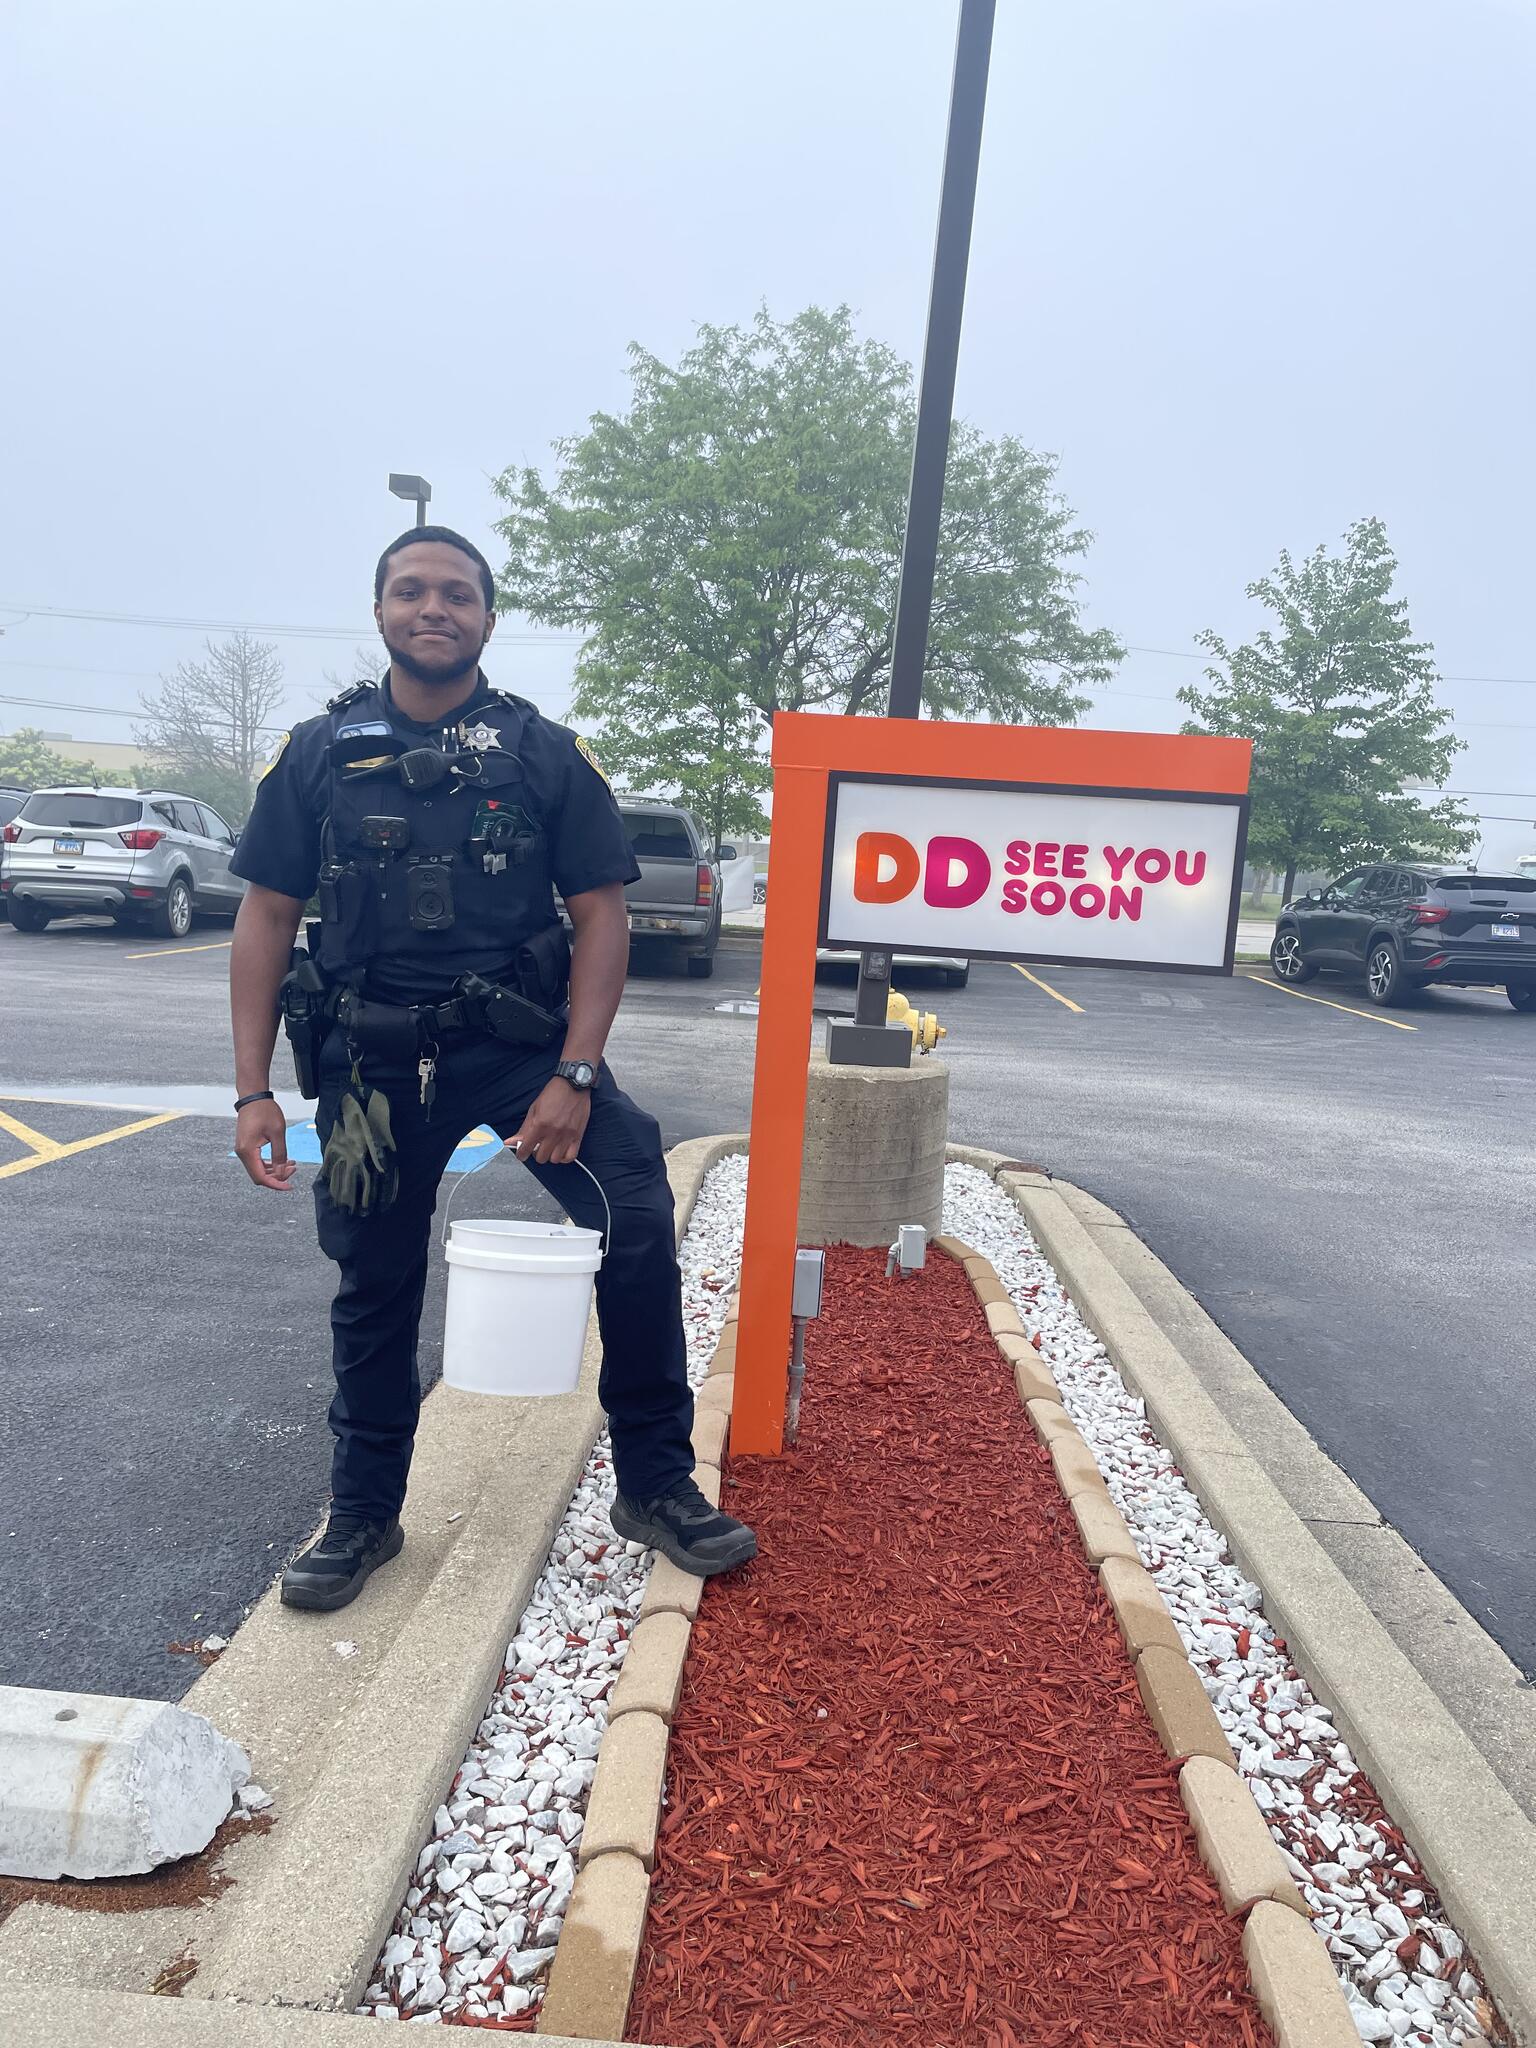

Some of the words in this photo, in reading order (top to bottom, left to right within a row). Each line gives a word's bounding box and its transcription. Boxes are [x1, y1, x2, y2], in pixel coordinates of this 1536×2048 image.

[853, 831, 992, 909] DD
[1004, 840, 1089, 879] SEE
[1103, 846, 1206, 886] YOU
[1000, 878, 1143, 922] SOON
